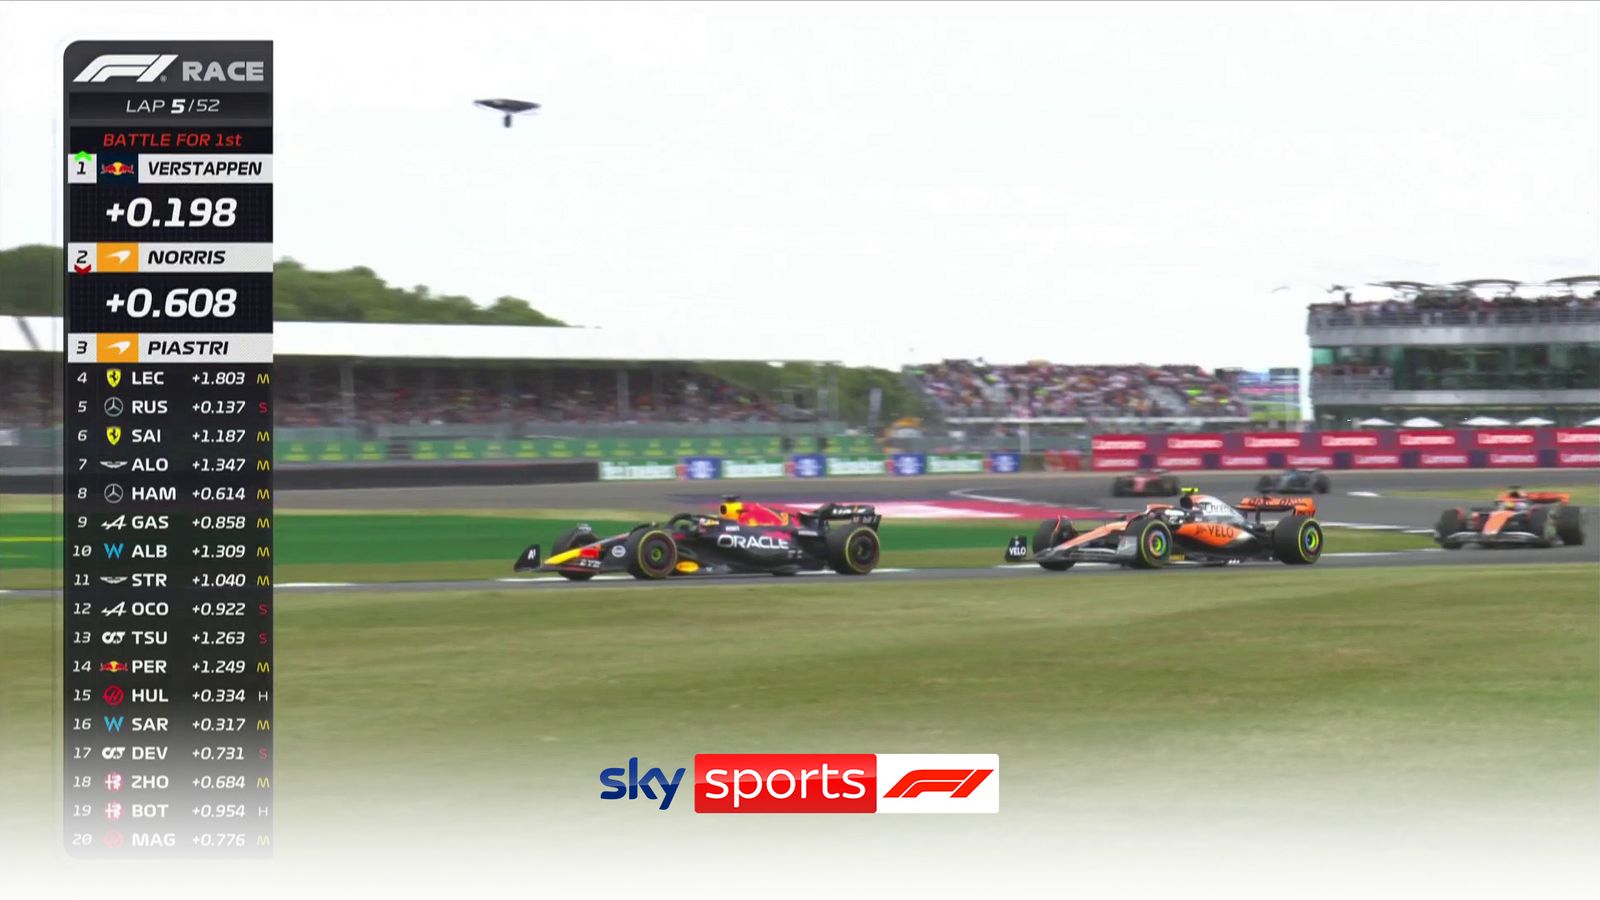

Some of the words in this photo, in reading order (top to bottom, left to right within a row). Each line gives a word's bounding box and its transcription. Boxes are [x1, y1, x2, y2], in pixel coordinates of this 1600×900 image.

[1208, 525, 1234, 538] VELO
[716, 534, 790, 549] ORACLE
[1009, 547, 1027, 556] VELO
